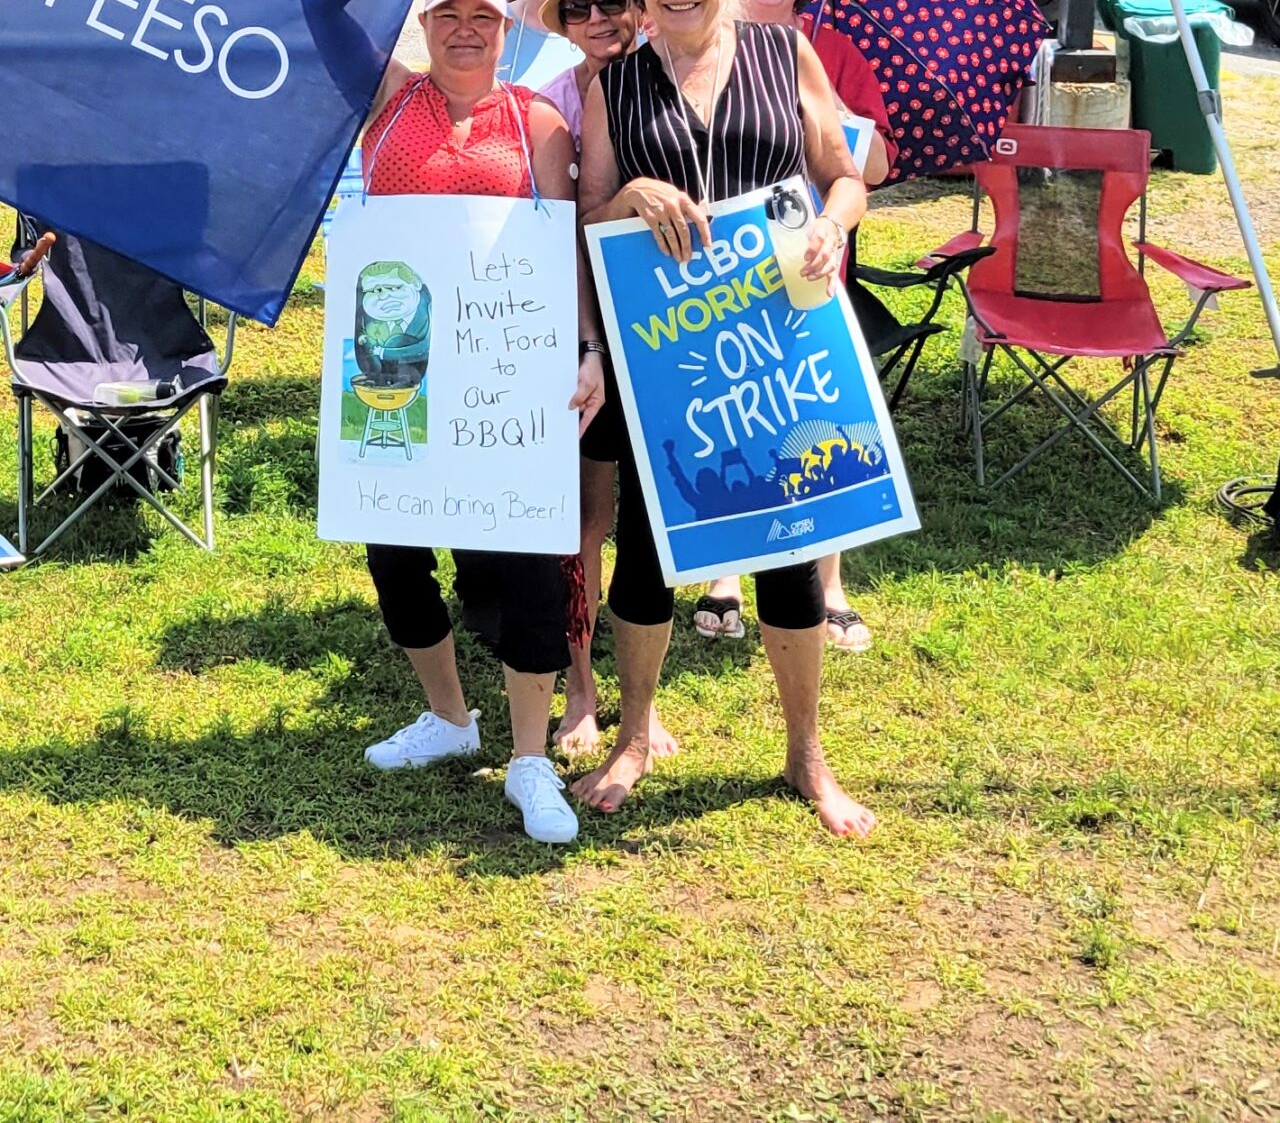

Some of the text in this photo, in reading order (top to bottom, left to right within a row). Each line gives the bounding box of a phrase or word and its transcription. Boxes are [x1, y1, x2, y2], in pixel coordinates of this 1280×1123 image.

[470, 251, 534, 281] Let's
[654, 223, 765, 299] LCBO
[456, 286, 546, 323] Invite
[456, 329, 489, 355] Mr.
[503, 326, 557, 352] Ford
[714, 308, 783, 380] ON
[491, 356, 516, 376] to
[685, 350, 839, 458] STRIKE
[449, 407, 545, 447] BBQ!!
[357, 480, 565, 531] He can bring Beer!
